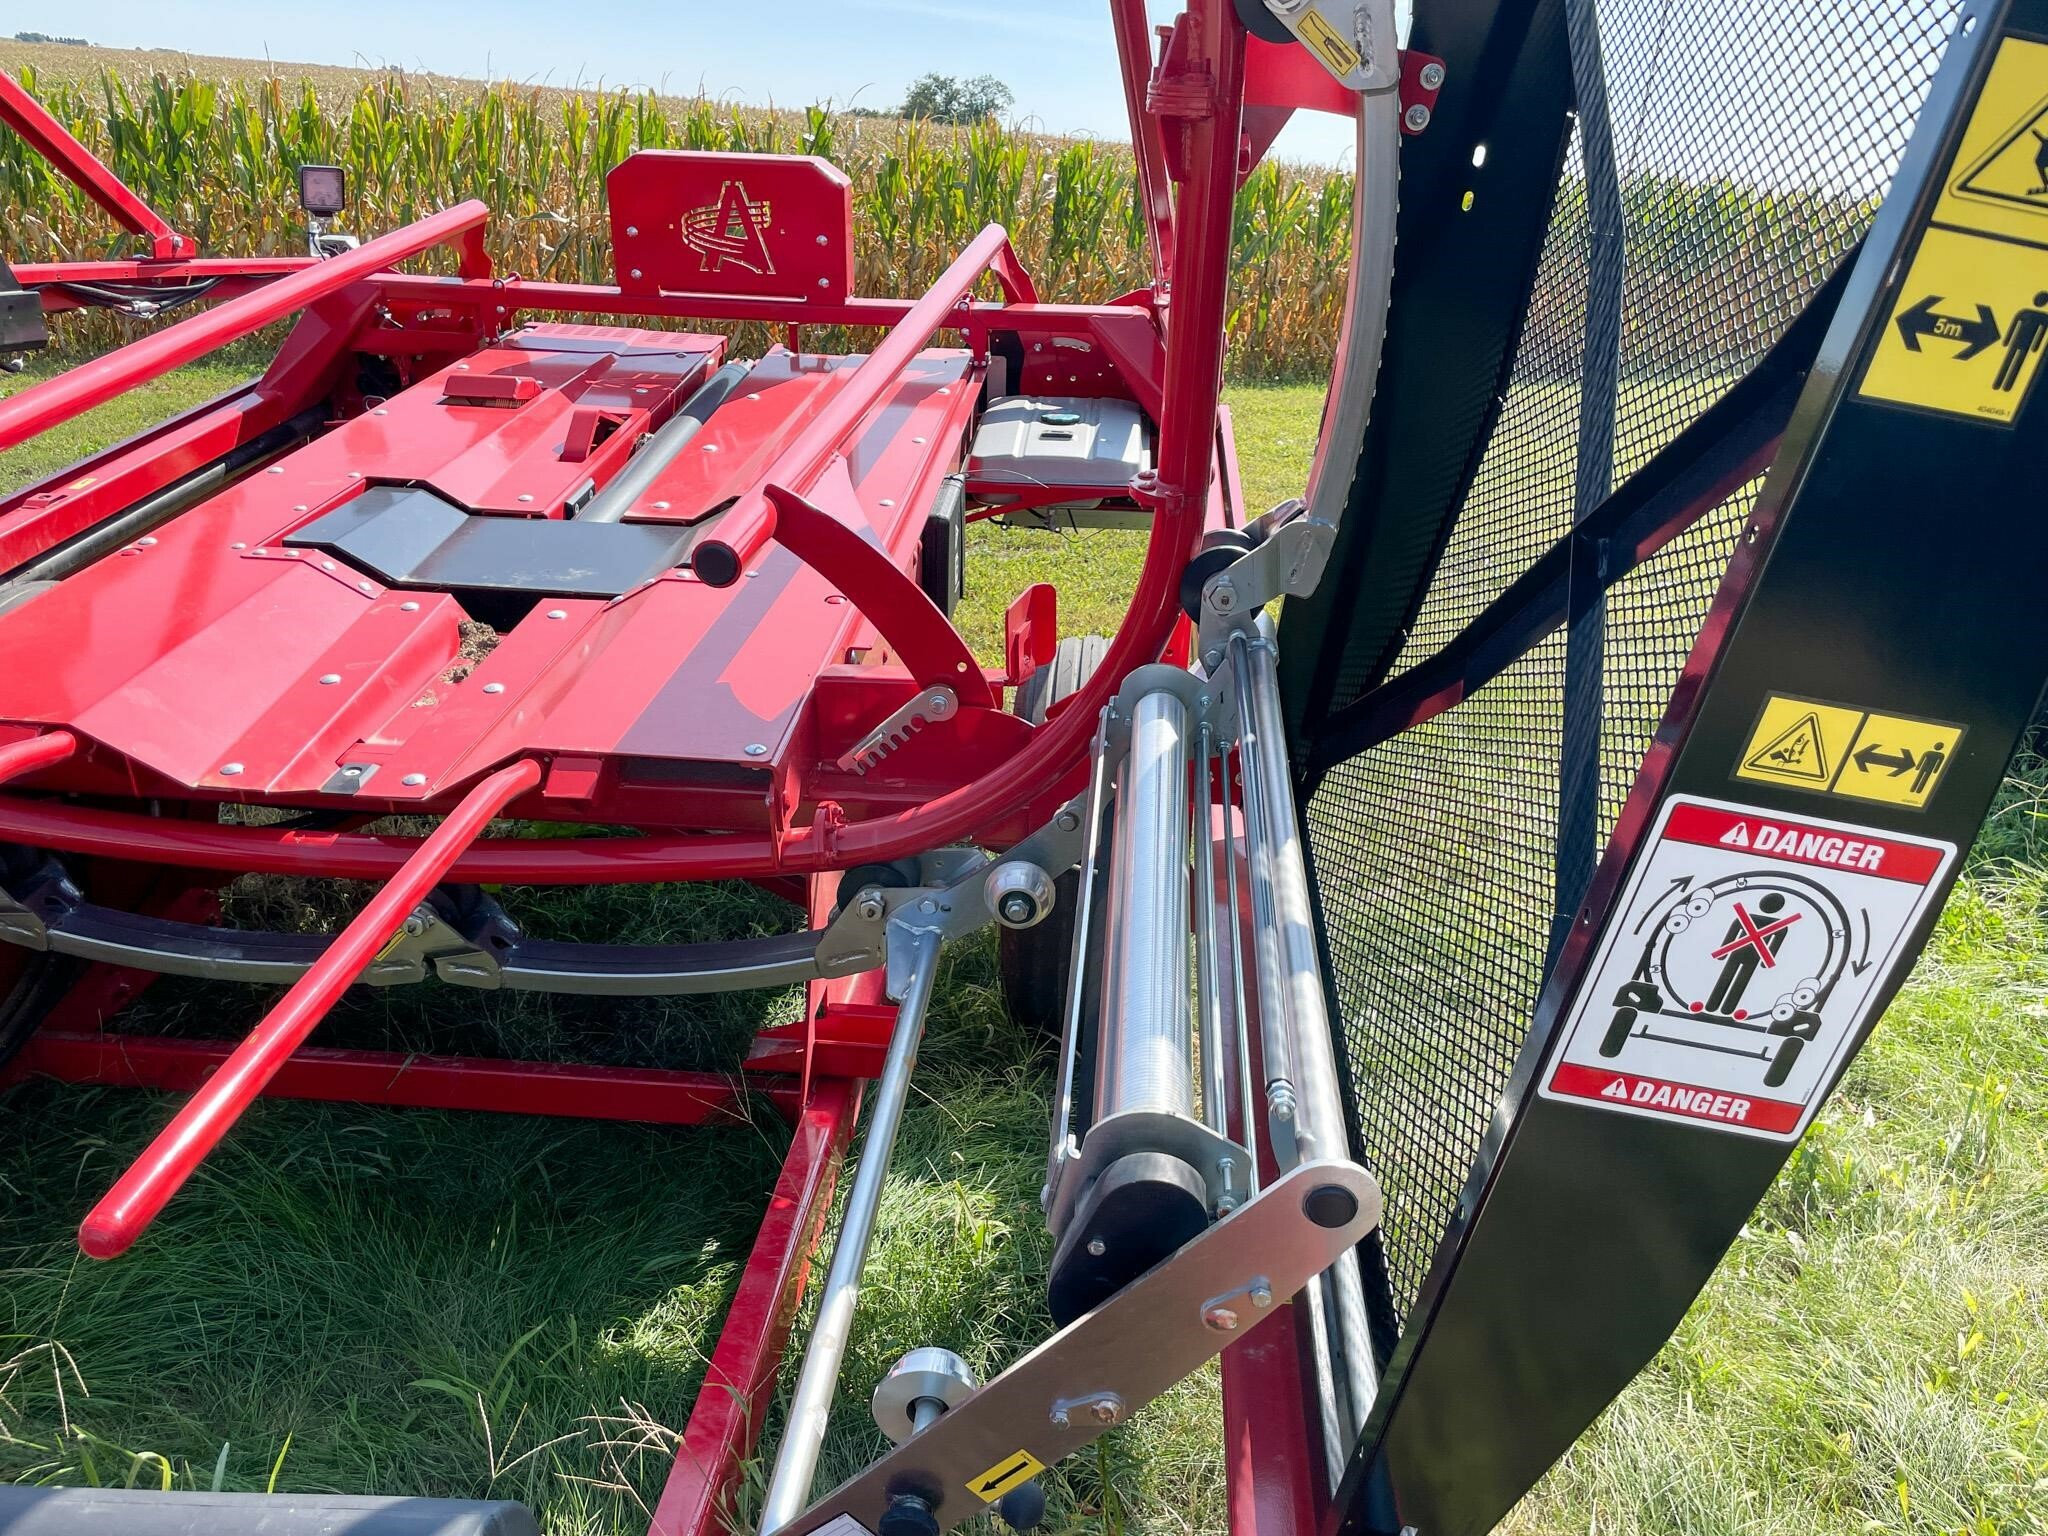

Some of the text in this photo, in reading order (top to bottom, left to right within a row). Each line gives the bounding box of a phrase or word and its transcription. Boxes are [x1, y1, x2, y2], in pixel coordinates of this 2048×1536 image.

[1933, 318, 1963, 337] 5m
[1753, 825, 1885, 870] DANGER
[1631, 1081, 1751, 1121] DANGER
